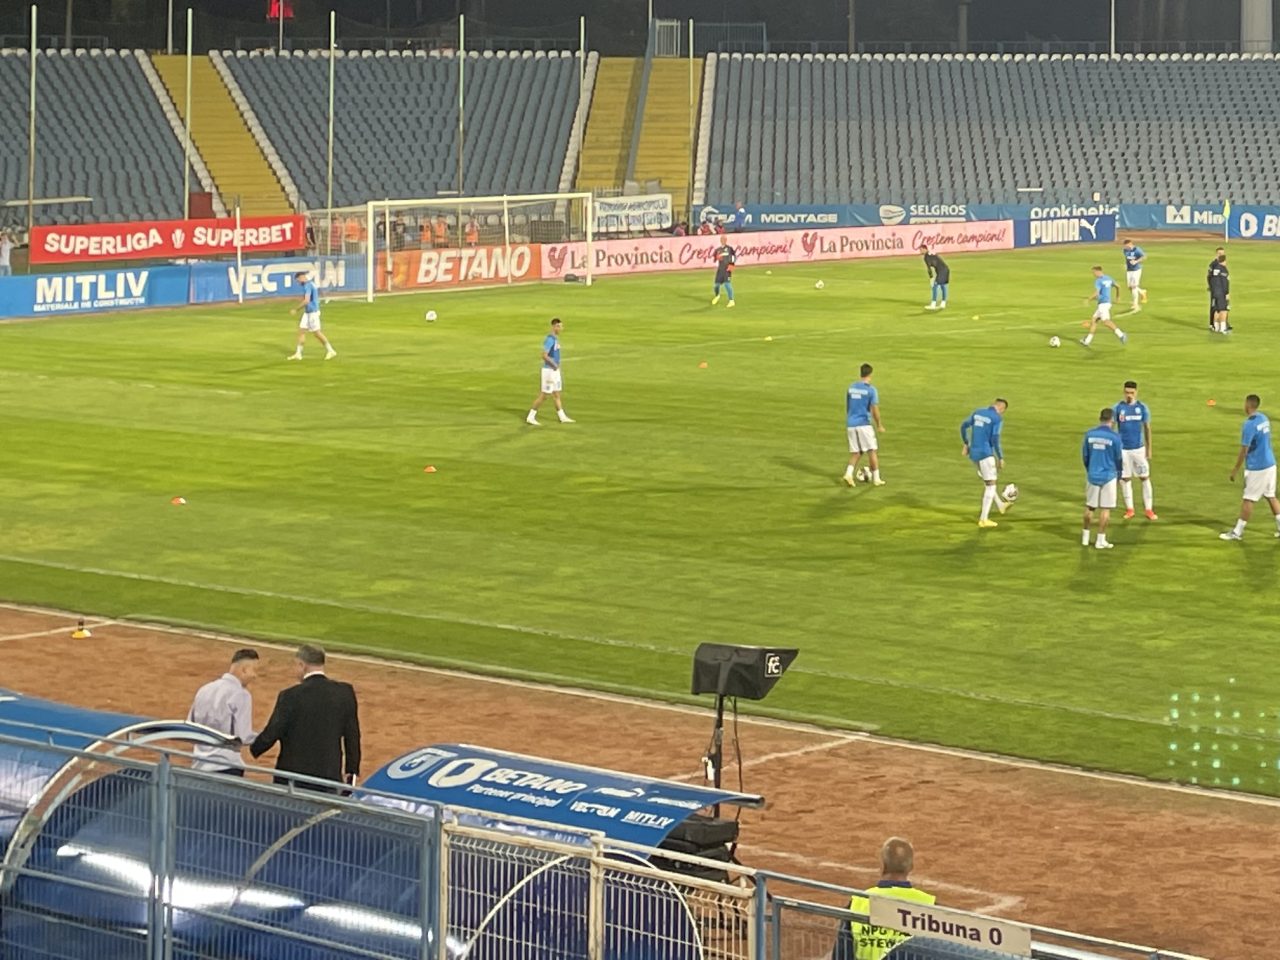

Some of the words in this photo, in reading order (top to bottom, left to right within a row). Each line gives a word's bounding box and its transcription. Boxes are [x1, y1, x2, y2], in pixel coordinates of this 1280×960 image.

[760, 213, 838, 223] MONTAGE
[910, 205, 966, 215] SELGROS
[44, 228, 163, 255] SUPERLIGA
[192, 222, 294, 247] SUPERBET
[1030, 219, 1080, 245] PUMA
[570, 250, 588, 270] La
[595, 245, 674, 268] Provincia
[820, 237, 837, 253] La
[840, 233, 904, 252] Provincia
[417, 246, 531, 284] BETANO
[36, 271, 149, 304] MITLIV
[481, 768, 588, 794] BETANO
[623, 810, 675, 827] MITLIV
[897, 908, 981, 942] Tribuna
[859, 937, 896, 949] STEW
